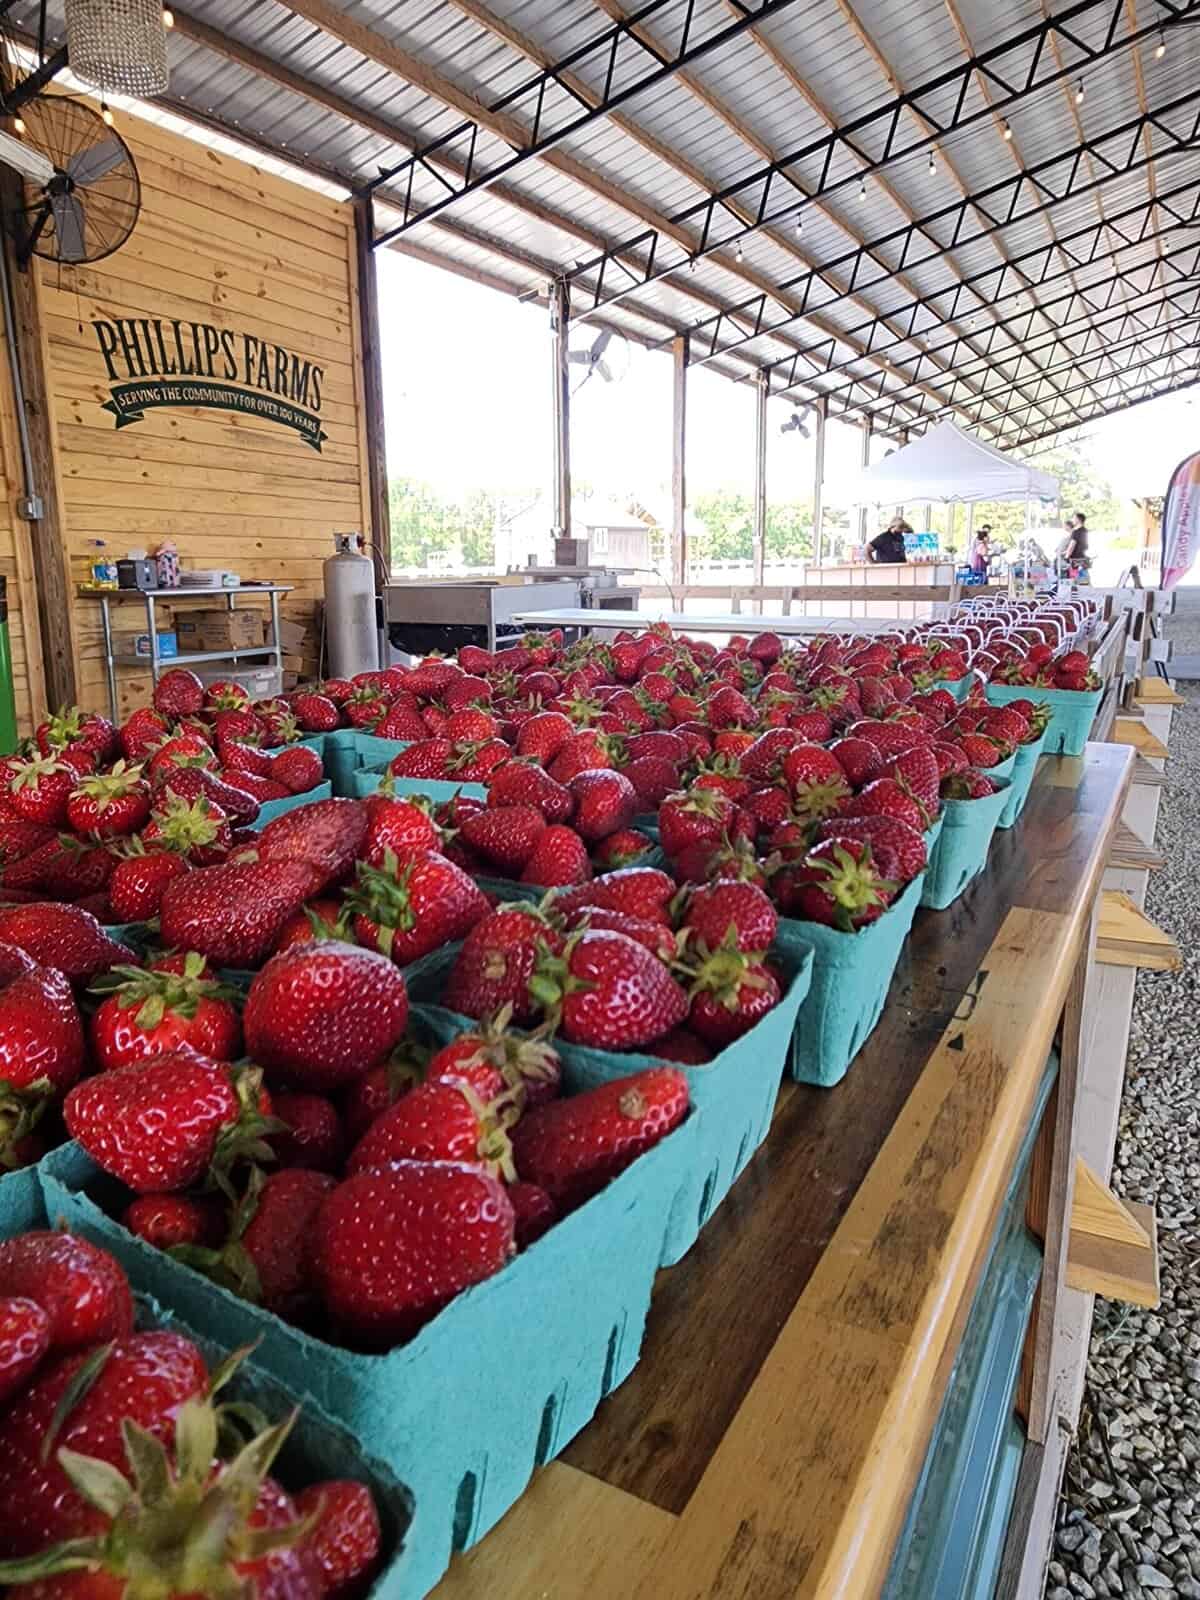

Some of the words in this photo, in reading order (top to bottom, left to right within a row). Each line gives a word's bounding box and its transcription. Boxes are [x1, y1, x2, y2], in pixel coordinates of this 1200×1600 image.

[91, 319, 238, 381] PHILLIPS
[242, 333, 324, 412] FARMS
[118, 387, 160, 406] SERVING
[161, 387, 181, 401] THE
[182, 387, 239, 406] COMMUNITY
[239, 395, 256, 410] FOR
[257, 400, 278, 417] OVER
[280, 406, 293, 422] 100
[293, 412, 318, 433] YEARS
[1176, 530, 1191, 568] Candy
